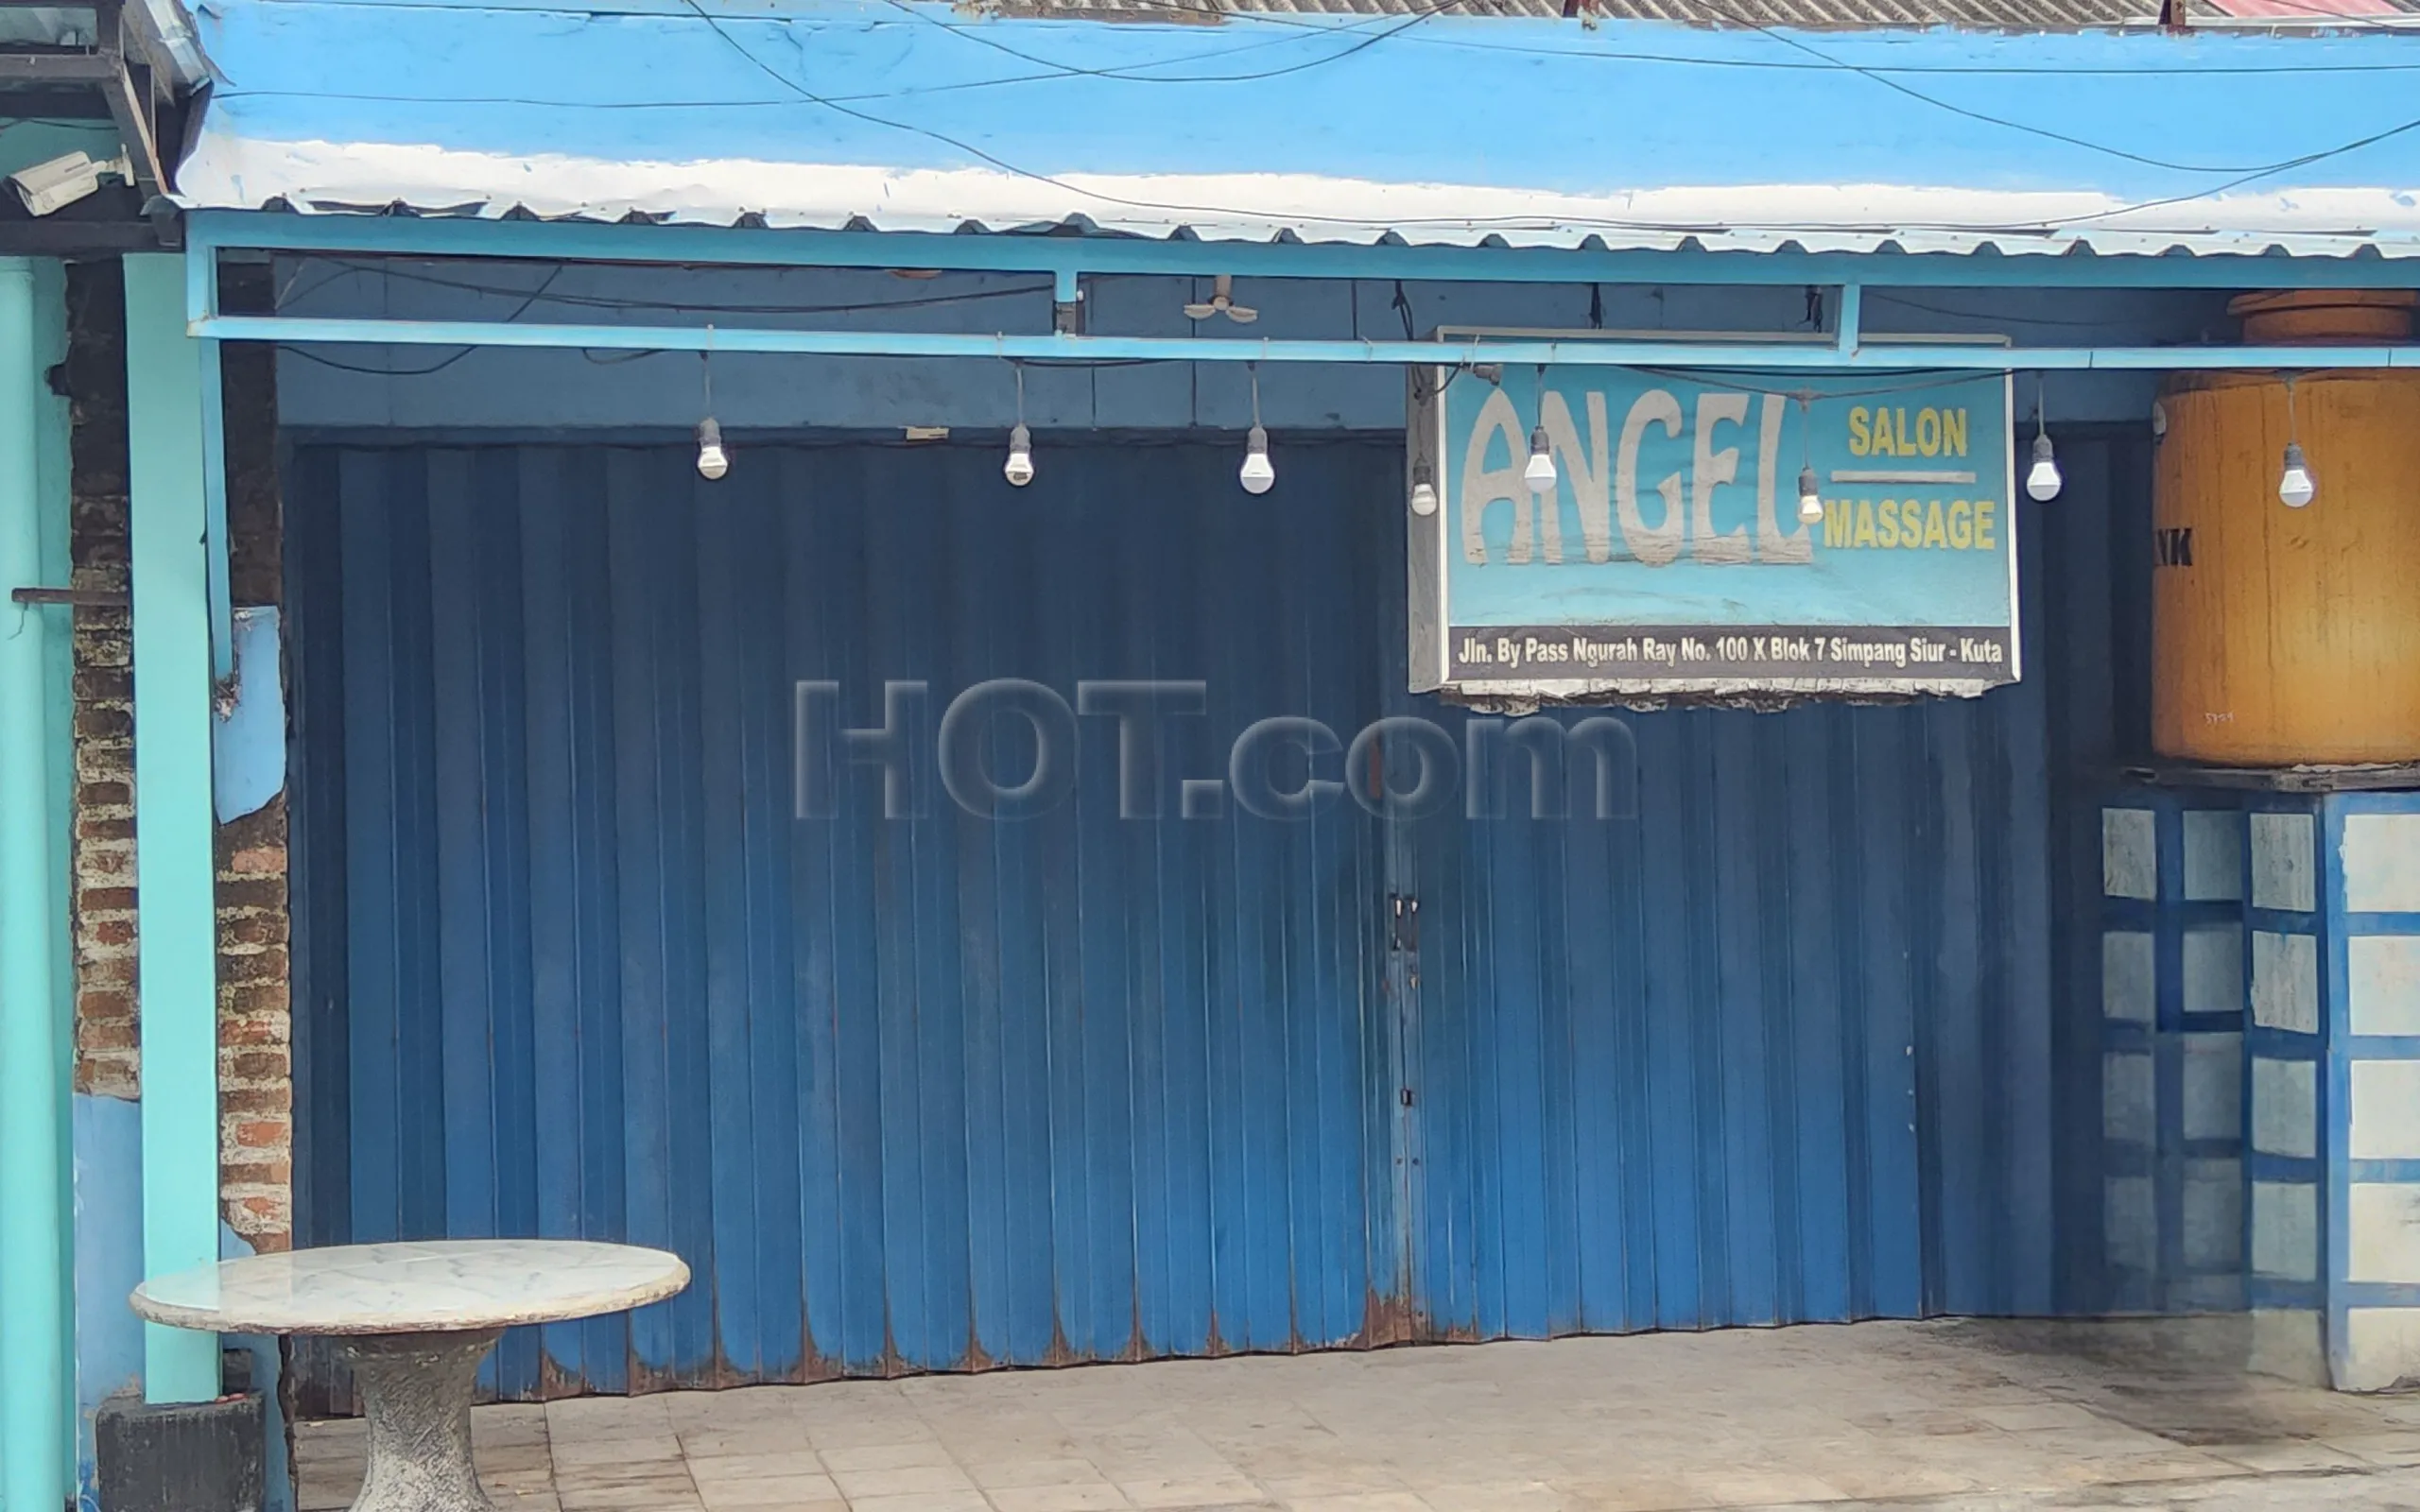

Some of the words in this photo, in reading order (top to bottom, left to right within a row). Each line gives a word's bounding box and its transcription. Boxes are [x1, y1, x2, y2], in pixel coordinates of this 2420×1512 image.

[1849, 406, 1967, 457] SALON
[1461, 388, 1813, 566] ANGEL
[1824, 499, 1996, 550] MASSAGE
[1459, 638, 1493, 662] Jln.
[1497, 638, 1521, 668] By
[1525, 638, 1568, 662] Pass
[1573, 638, 1638, 667] Ngurah
[1643, 638, 1676, 667] Ray
[1681, 638, 1712, 662] No.
[1716, 637, 1748, 662] 100
[1752, 637, 1767, 662] X
[1771, 637, 1810, 662] Blok
[1814, 637, 1826, 662] 7
[1830, 637, 1906, 668] Simpang
[1910, 637, 1946, 662] Siur
[1961, 637, 2002, 662] Kuta
